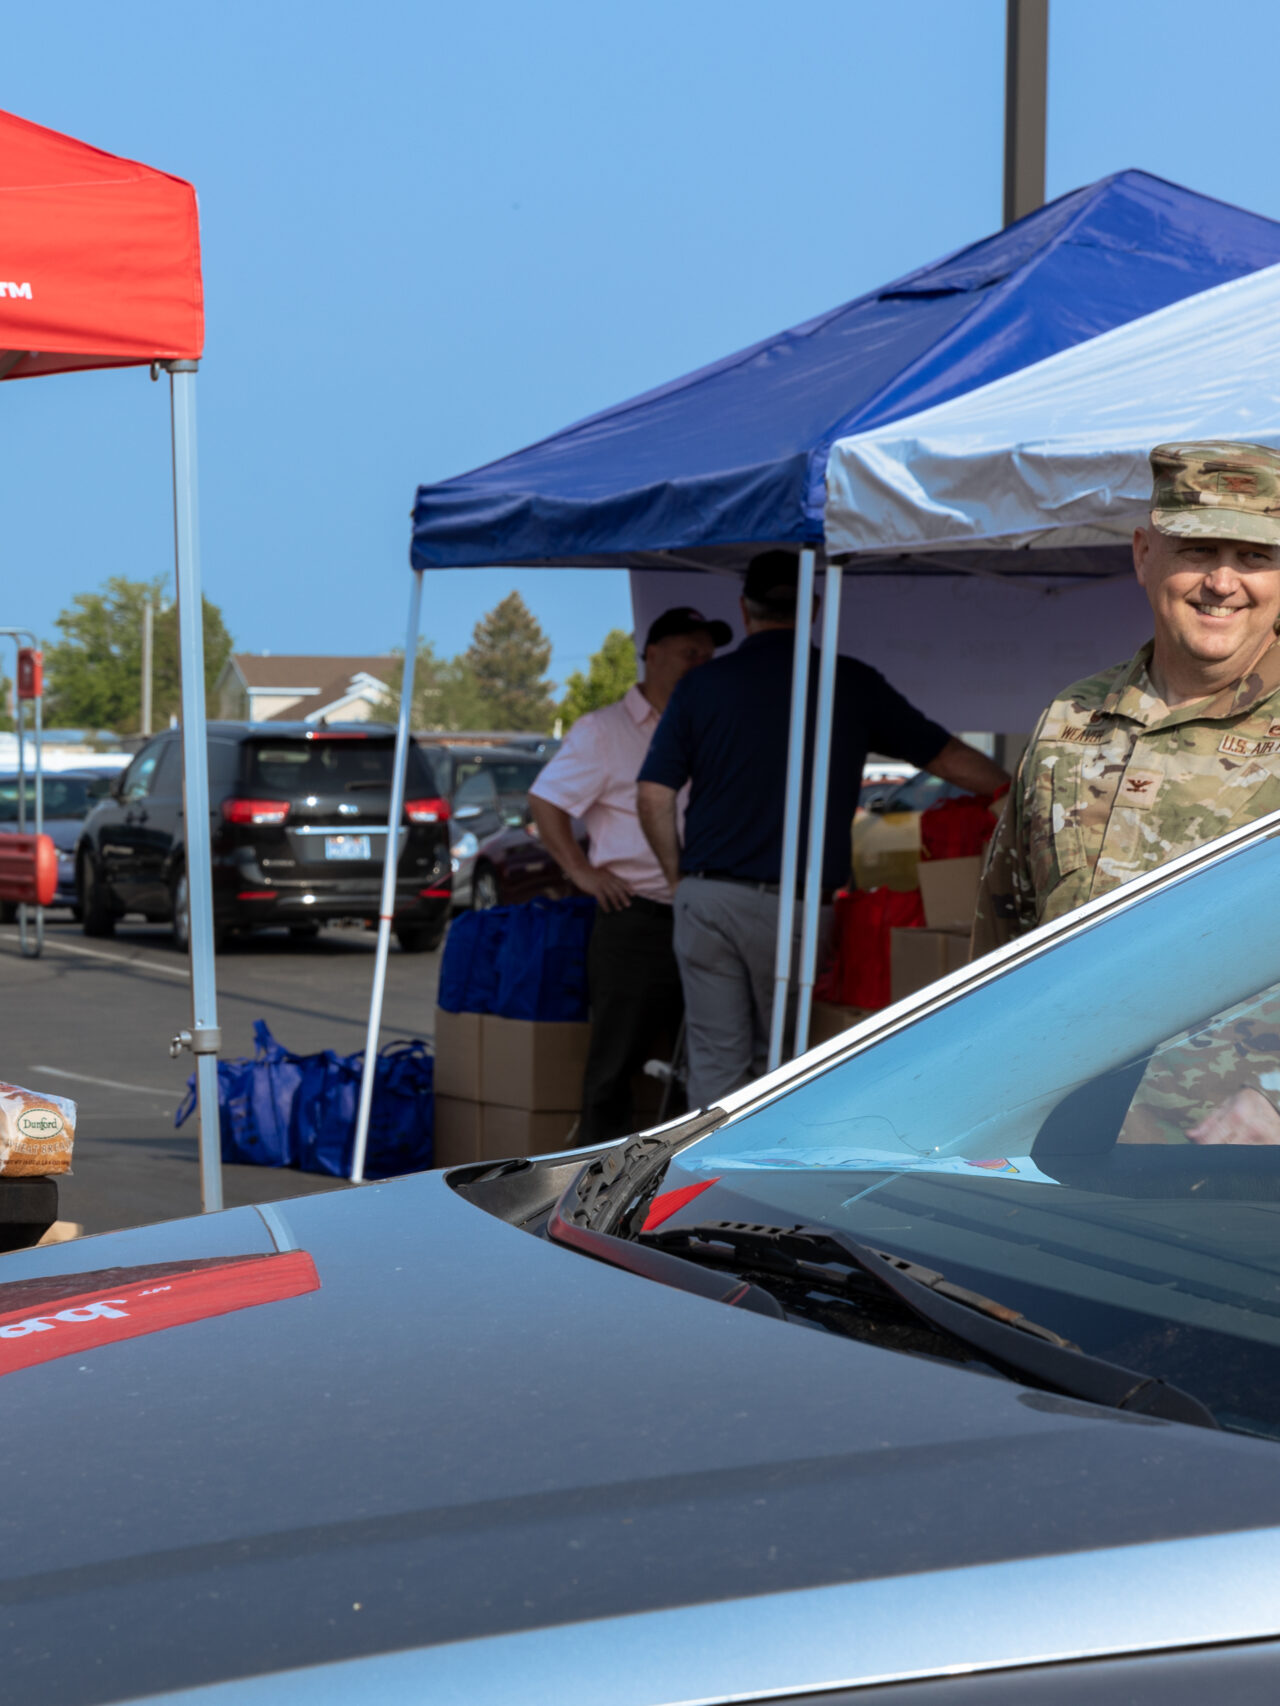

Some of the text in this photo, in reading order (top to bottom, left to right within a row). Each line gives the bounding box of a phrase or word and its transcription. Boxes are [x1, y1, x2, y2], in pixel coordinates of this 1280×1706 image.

[1060, 725, 1105, 743] WEAVER
[1222, 735, 1247, 755] U.S.
[24, 1116, 58, 1131] Dunford
